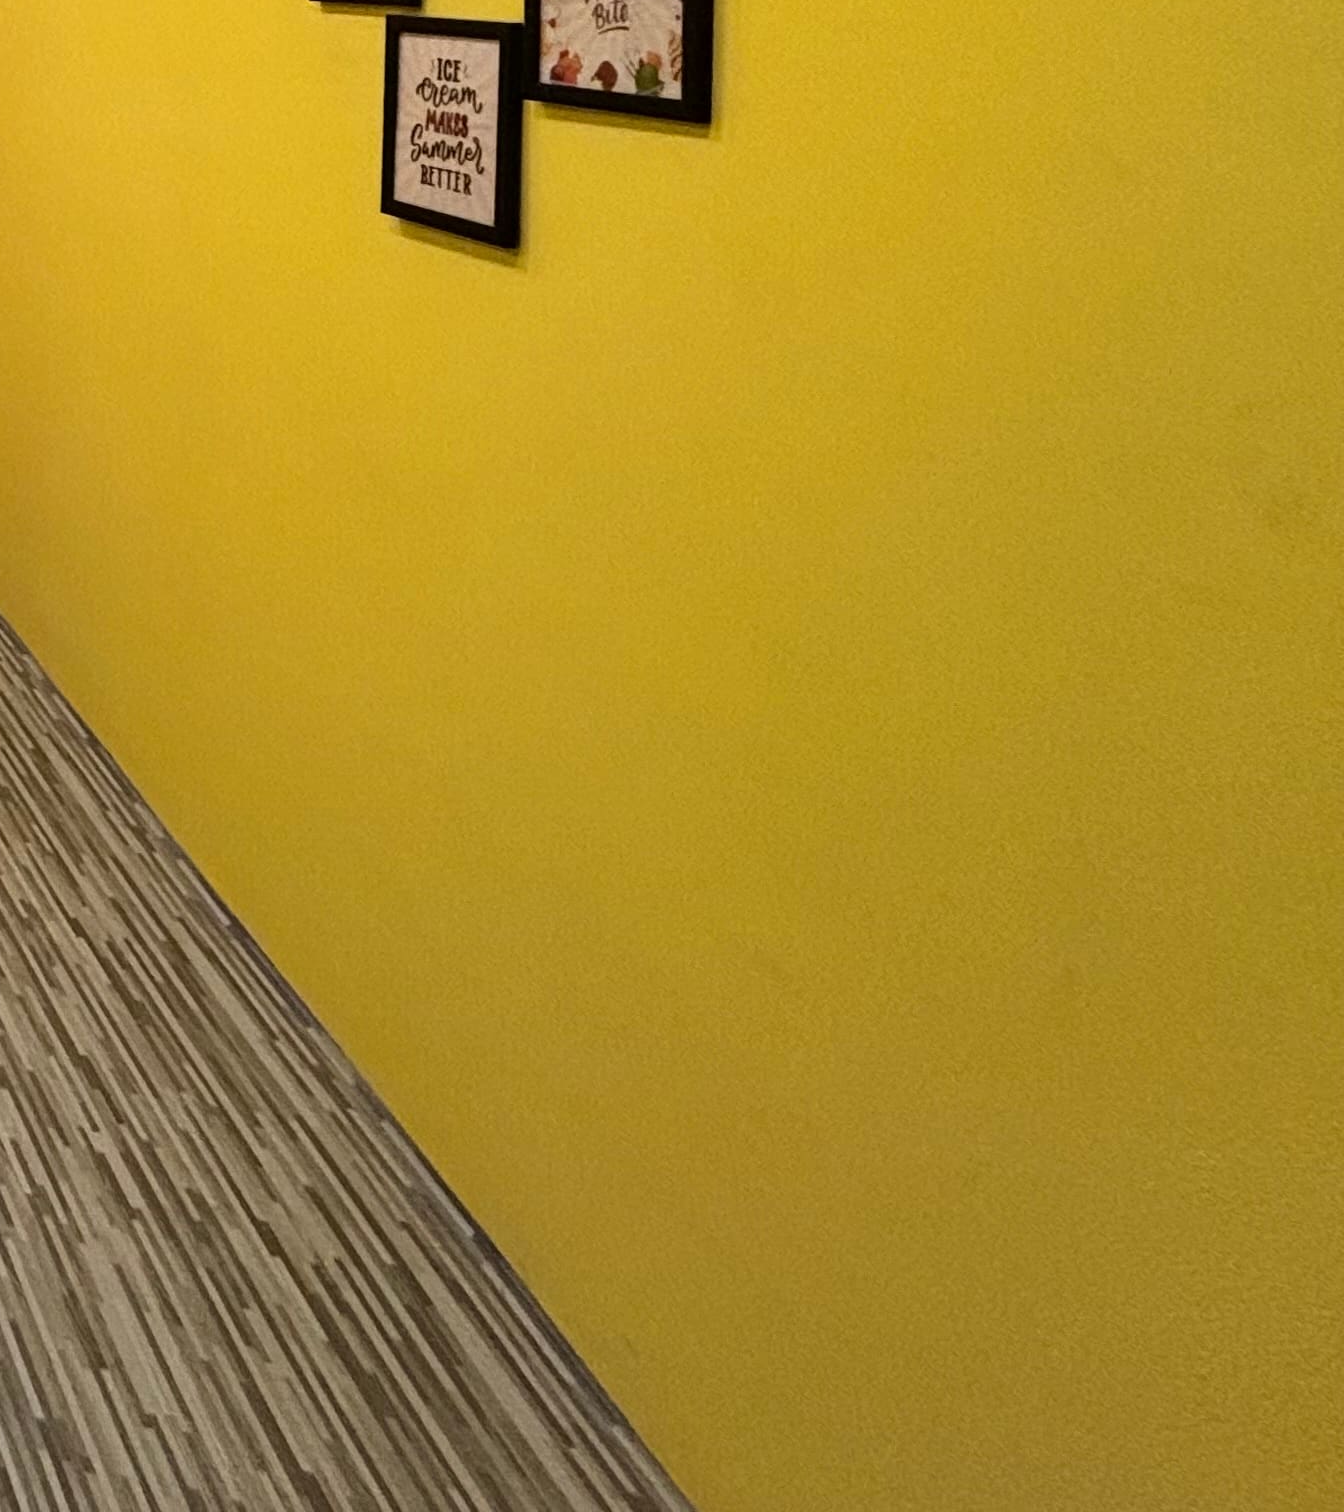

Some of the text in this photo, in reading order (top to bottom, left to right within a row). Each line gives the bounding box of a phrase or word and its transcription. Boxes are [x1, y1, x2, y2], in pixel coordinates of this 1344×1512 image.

[436, 57, 462, 83] ICE
[425, 109, 469, 138] MAKES
[420, 164, 472, 196] BETTER
